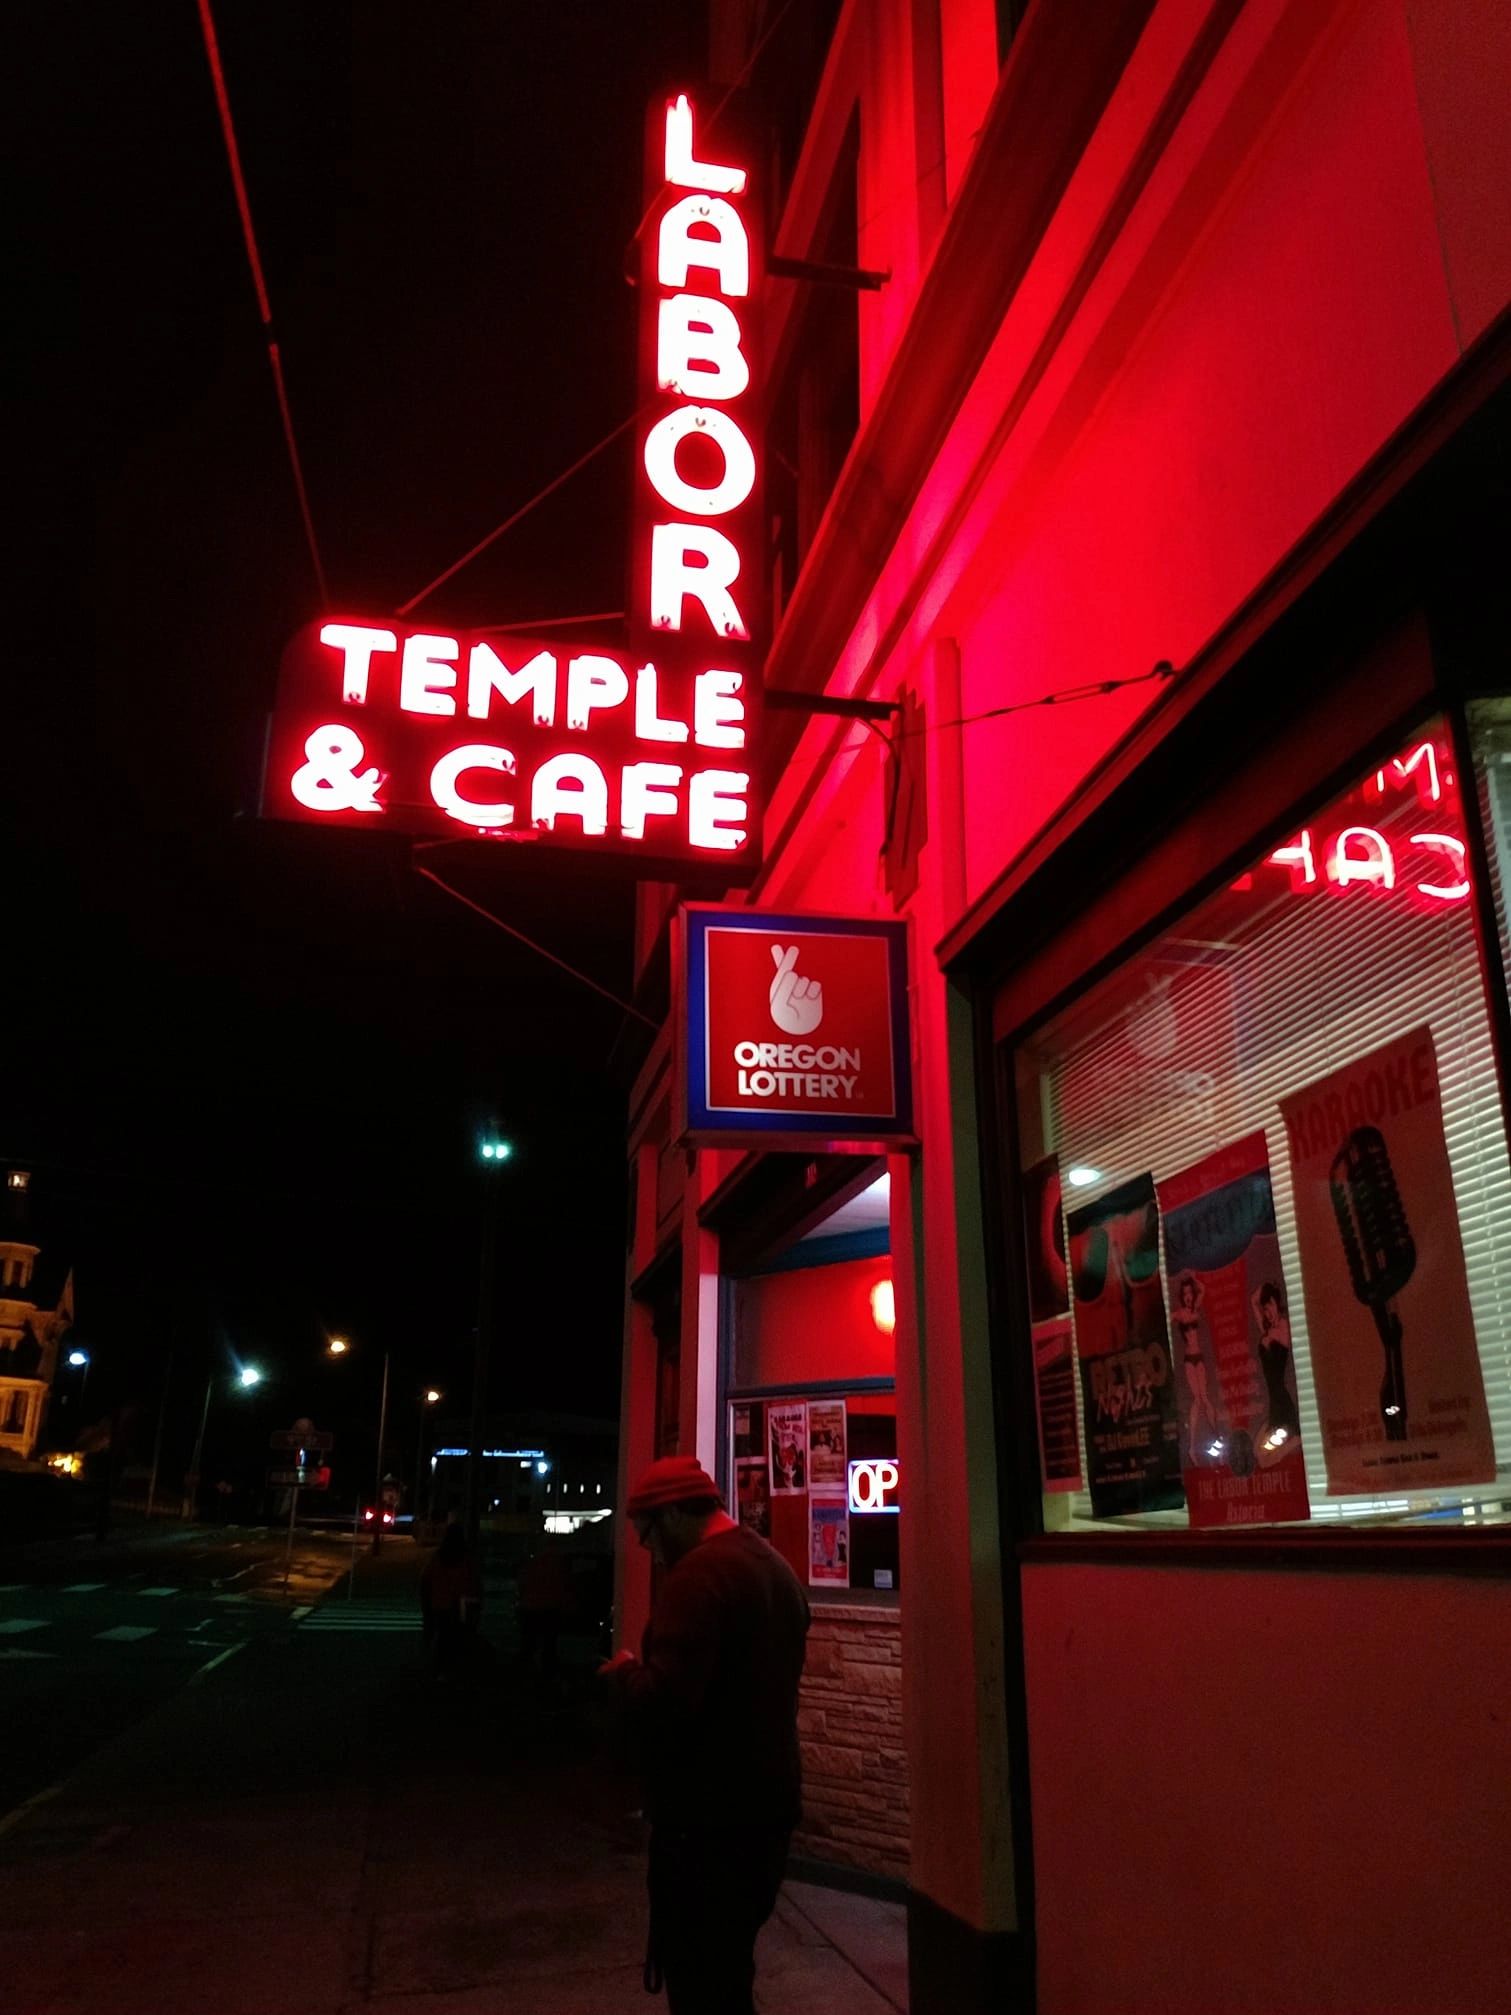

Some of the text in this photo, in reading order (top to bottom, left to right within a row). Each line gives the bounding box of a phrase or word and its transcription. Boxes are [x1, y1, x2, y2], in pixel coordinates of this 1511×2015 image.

[644, 94, 756, 640] LABOR
[320, 624, 746, 749] TEMPLE
[291, 724, 750, 850] & CAFE
[734, 1041, 861, 1072] OREGON
[738, 1070, 858, 1099] LOTTERY
[1288, 1045, 1436, 1162] KARAOKE
[852, 1463, 898, 1509] OP
[1252, 1470, 1292, 1496] TEMPLE
